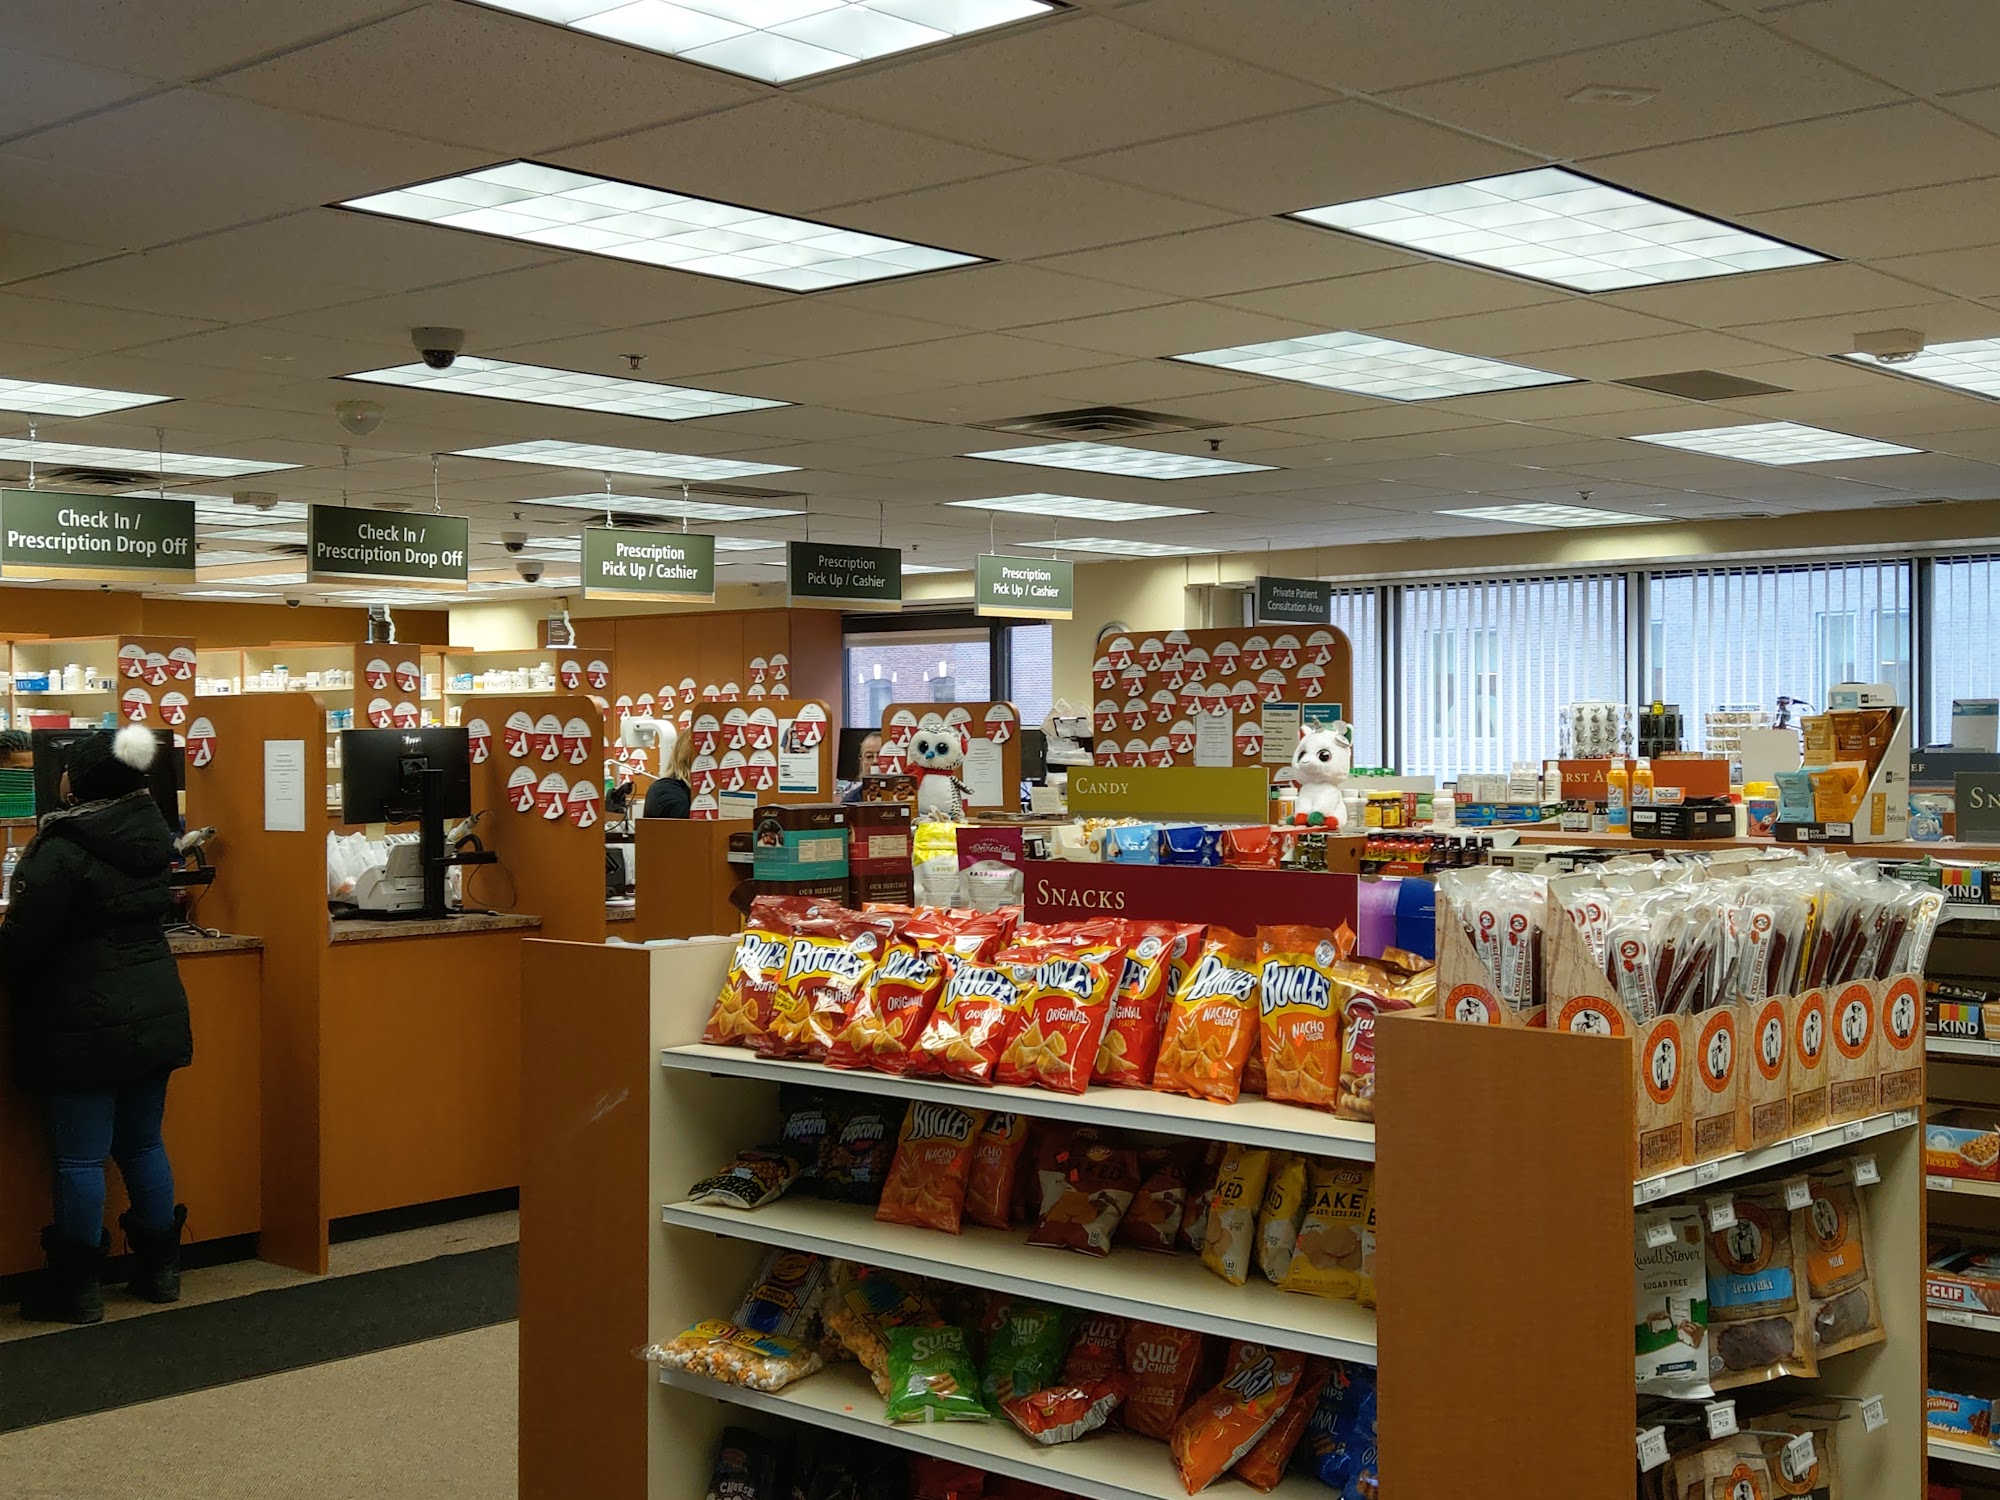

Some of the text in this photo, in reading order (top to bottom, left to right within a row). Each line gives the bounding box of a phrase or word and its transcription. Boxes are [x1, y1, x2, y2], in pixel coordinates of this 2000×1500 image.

[57, 508, 142, 531] Check In /
[358, 523, 426, 544] Check In /
[7, 530, 188, 558] Prescription Drop Off
[616, 542, 685, 562] Prescription
[317, 542, 463, 569] Prescription Drop Off
[818, 554, 876, 571] Prescription
[602, 560, 698, 580] Pick Up / Cashier
[1002, 566, 1051, 583] Prescription
[807, 572, 827, 585] Pick
[829, 573, 843, 588] Up
[852, 574, 886, 588] Cashier
[993, 582, 1010, 595] Pick
[1011, 584, 1024, 598] Up
[1030, 584, 1060, 597] Cashier
[1272, 586, 1319, 599] Private Patient
[1267, 600, 1324, 613] Consultation Area
[1560, 773, 1590, 783] IRST
[798, 886, 843, 896] OUR HERITAGE
[1036, 879, 1126, 910] SNACKS
[1941, 884, 1982, 899] KIND
[1184, 955, 1259, 1001] BUGLES
[1260, 960, 1331, 1017] BUGLES
[1045, 1007, 1089, 1025] ORIGINAL
[1202, 1006, 1240, 1022] NACHO
[1292, 1020, 1325, 1038] NACHO
[1939, 1020, 1979, 1035] KIND
[903, 1101, 975, 1142] BUGLES
[924, 1147, 956, 1161] NACHO
[1331, 1210, 1348, 1218] LESS
[1665, 1245, 1701, 1264] Stover
[1643, 1278, 1689, 1290] SUGAR FREE
[1086, 1337, 1118, 1350] CHIPS
[1132, 1341, 1180, 1374] Sun
[1148, 1363, 1178, 1375] CHIPS
[719, 1481, 756, 1497] CHEESE
